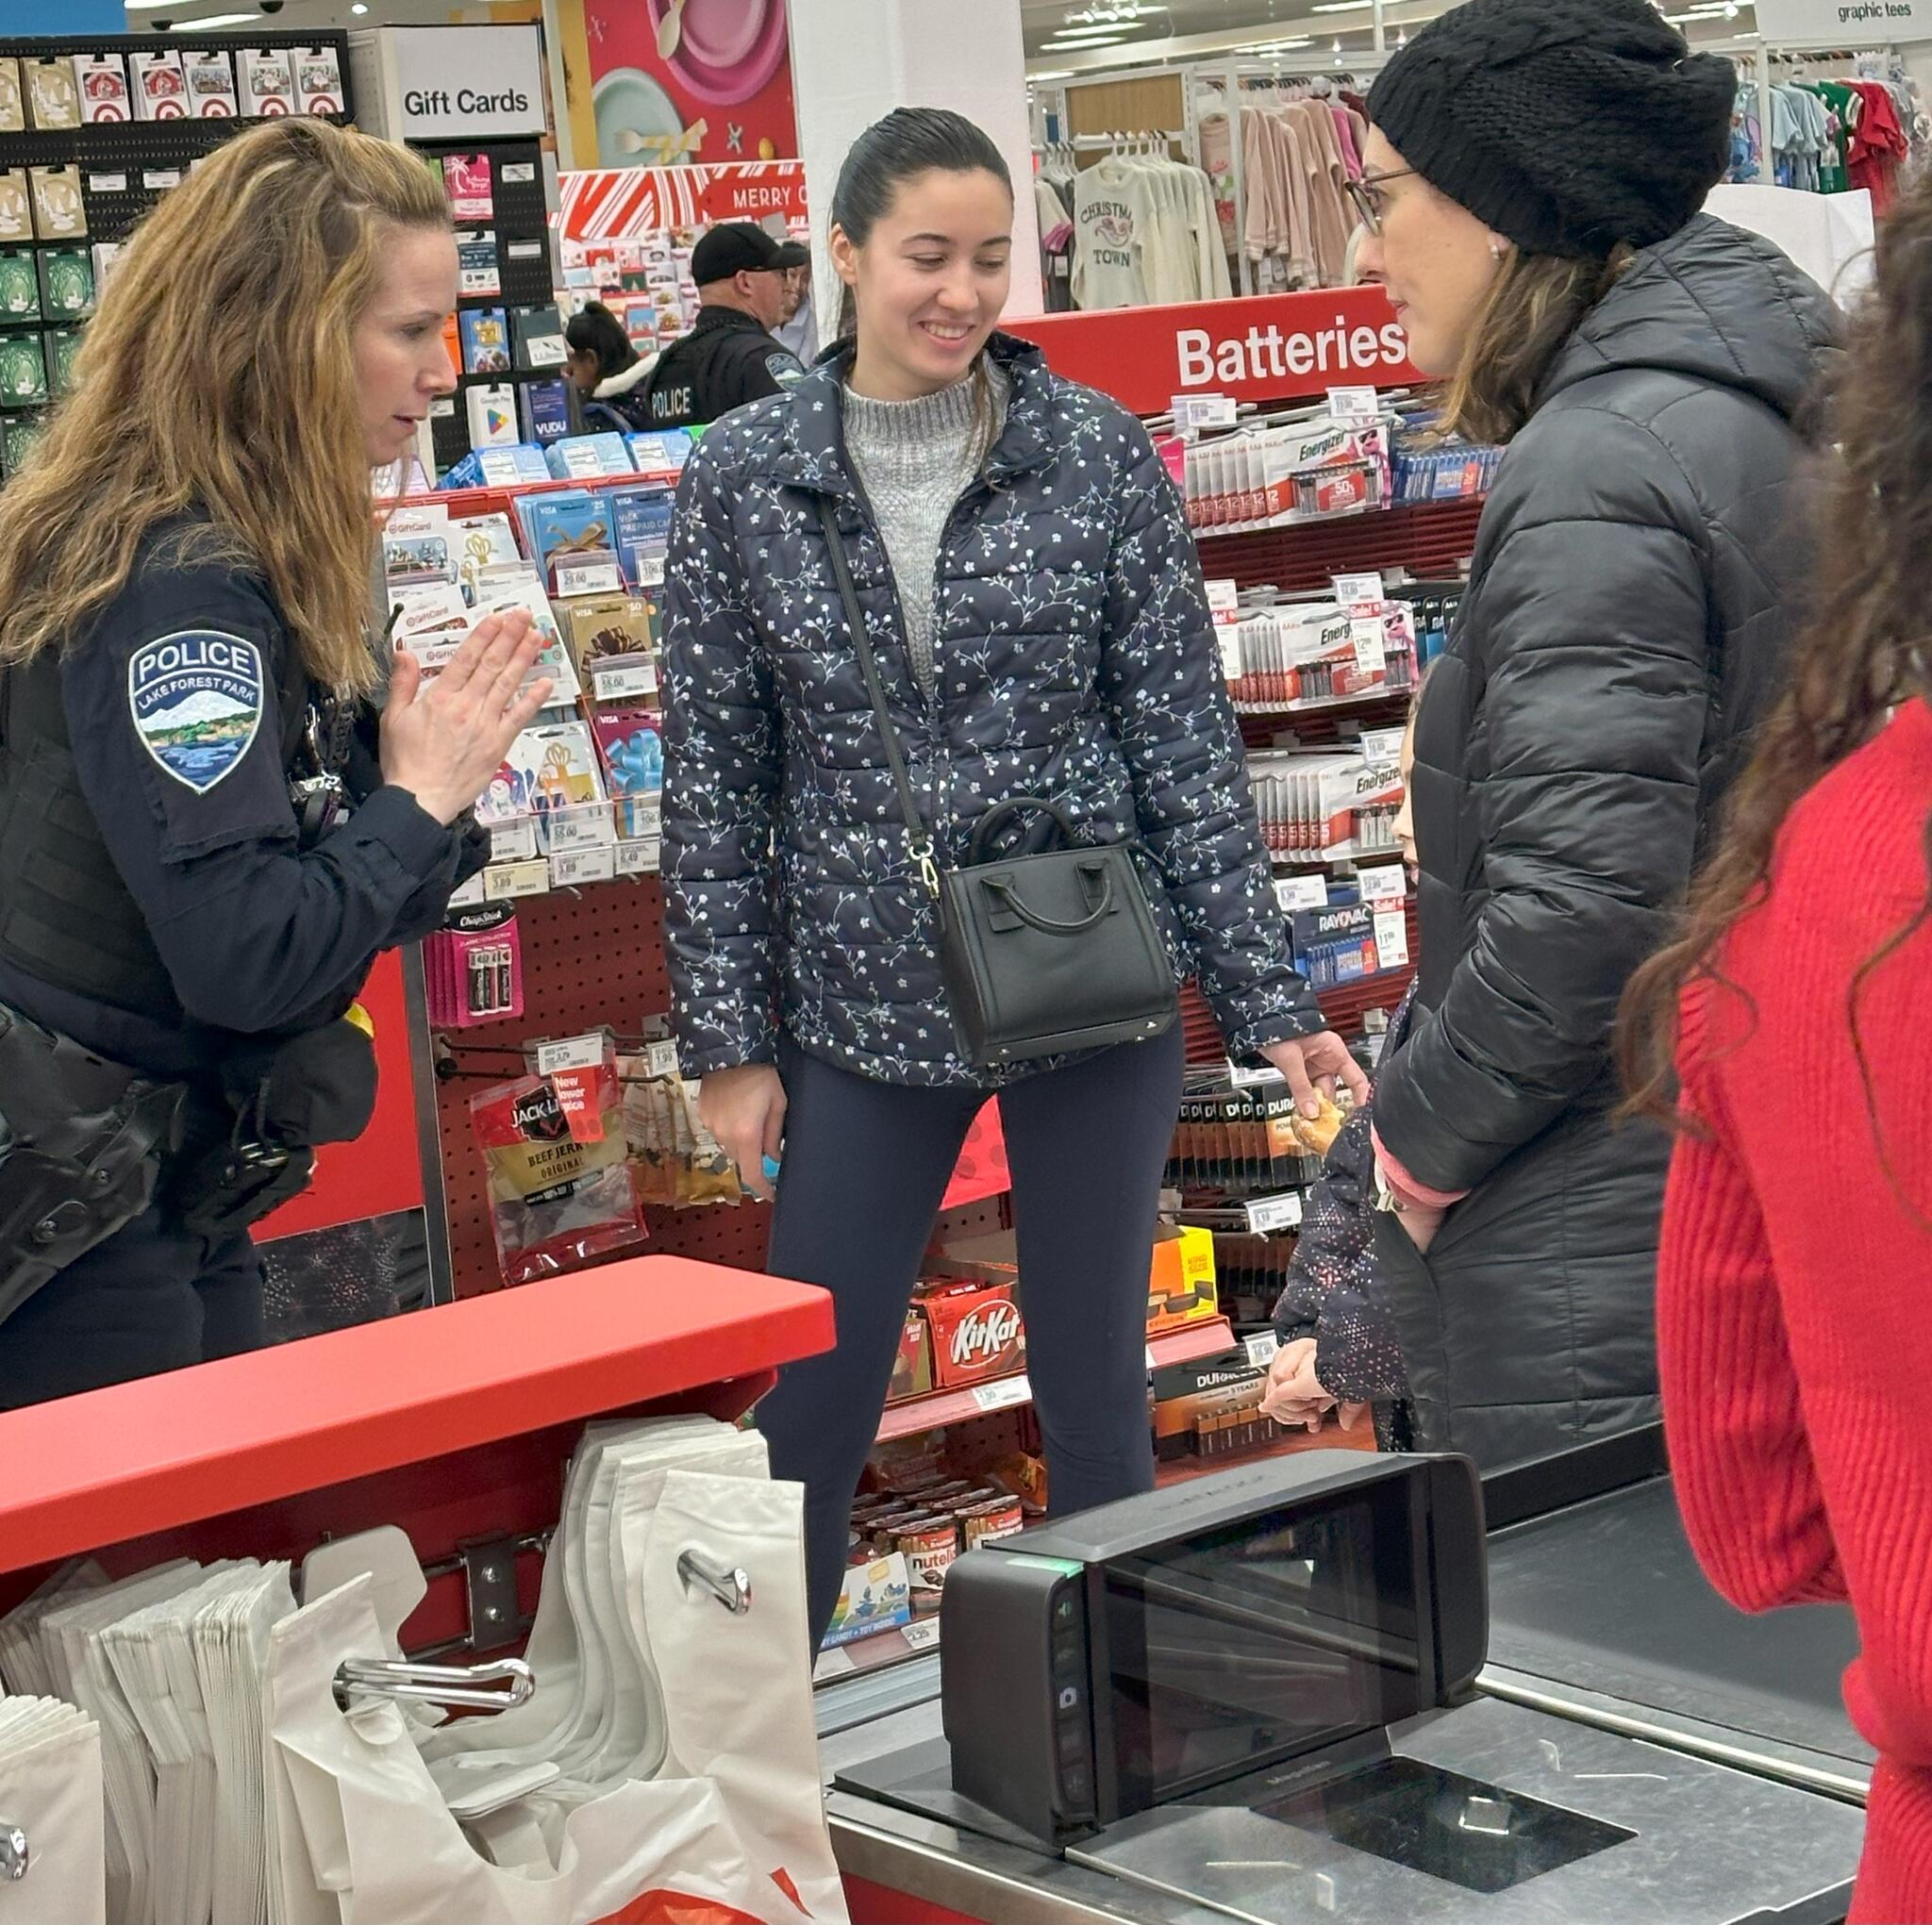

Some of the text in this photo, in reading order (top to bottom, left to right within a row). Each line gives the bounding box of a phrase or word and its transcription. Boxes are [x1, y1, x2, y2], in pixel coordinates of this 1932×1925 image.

[1838, 1, 1911, 23] graphic tees
[405, 88, 528, 116] Gift Cards
[733, 187, 791, 208] MERRY
[1080, 201, 1132, 224] CHRISTM
[1093, 249, 1130, 267] TOWN
[1176, 315, 1407, 387] Batteries
[652, 387, 691, 419] POLICE
[536, 421, 566, 435] VUDU
[1299, 430, 1345, 461] Energizer
[616, 496, 633, 506] VISA
[539, 505, 557, 515] VISA
[621, 521, 656, 534] PREPAID
[415, 606, 449, 623] GiftCard
[575, 608, 592, 618] VISA
[1349, 606, 1373, 619] Sale!
[1321, 623, 1352, 645] Energ
[139, 641, 251, 683] POLICE
[138, 676, 256, 709] LAKE FOREST PARK
[600, 715, 619, 724] VISA
[1357, 766, 1402, 794] Energize
[1269, 825, 1276, 838] 5
[1279, 825, 1287, 838] 5
[1290, 825, 1297, 838] 5
[1300, 824, 1307, 838] 5
[1311, 824, 1319, 838] 5
[1322, 823, 1330, 837] 5
[1374, 899, 1396, 913] Sale!
[1319, 906, 1370, 932] RAYOVAC
[555, 1075, 579, 1088] New
[1268, 1098, 1295, 1115] DURA
[512, 1104, 545, 1128] JACK
[527, 1150, 554, 1168] BEEF
[541, 1159, 585, 1179] ORIGINAL
[952, 1305, 1021, 1365] KitKat
